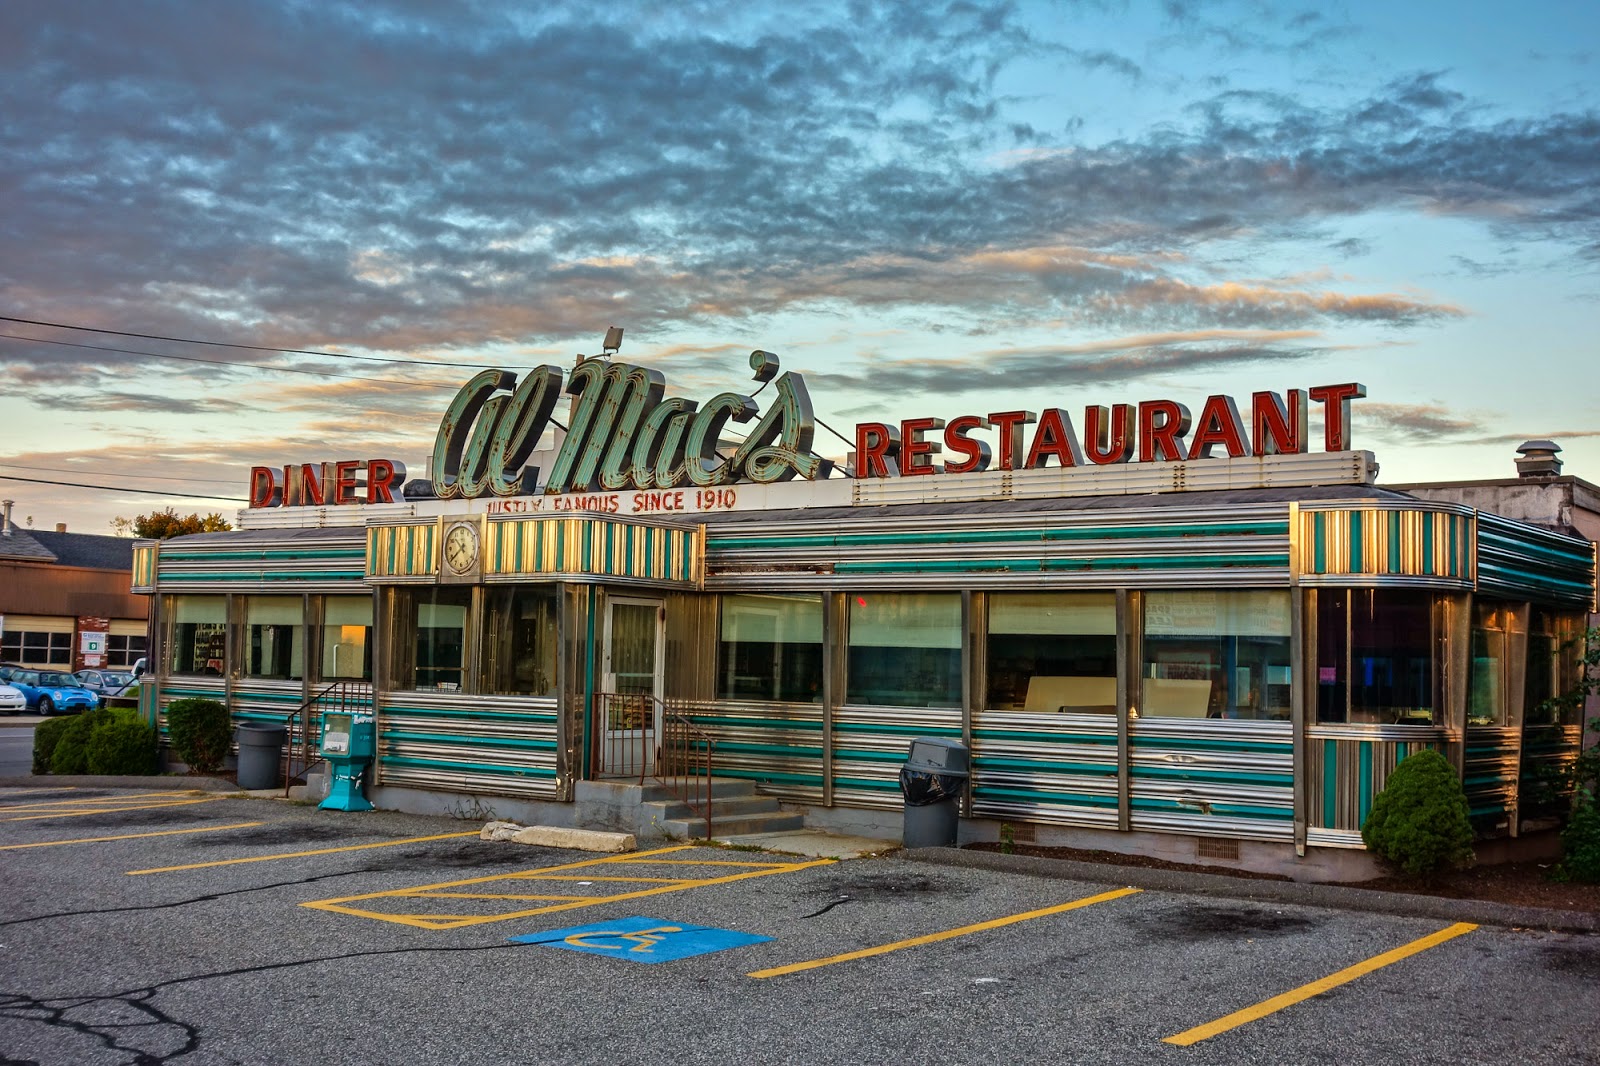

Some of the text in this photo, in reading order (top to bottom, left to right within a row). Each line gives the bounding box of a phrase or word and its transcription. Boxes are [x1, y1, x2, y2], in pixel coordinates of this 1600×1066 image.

[855, 382, 1362, 479] RESTAURANT
[250, 459, 402, 508] DINER
[553, 495, 619, 513] FAMOUS
[633, 491, 684, 512] SINCE
[696, 488, 737, 509] 1910
